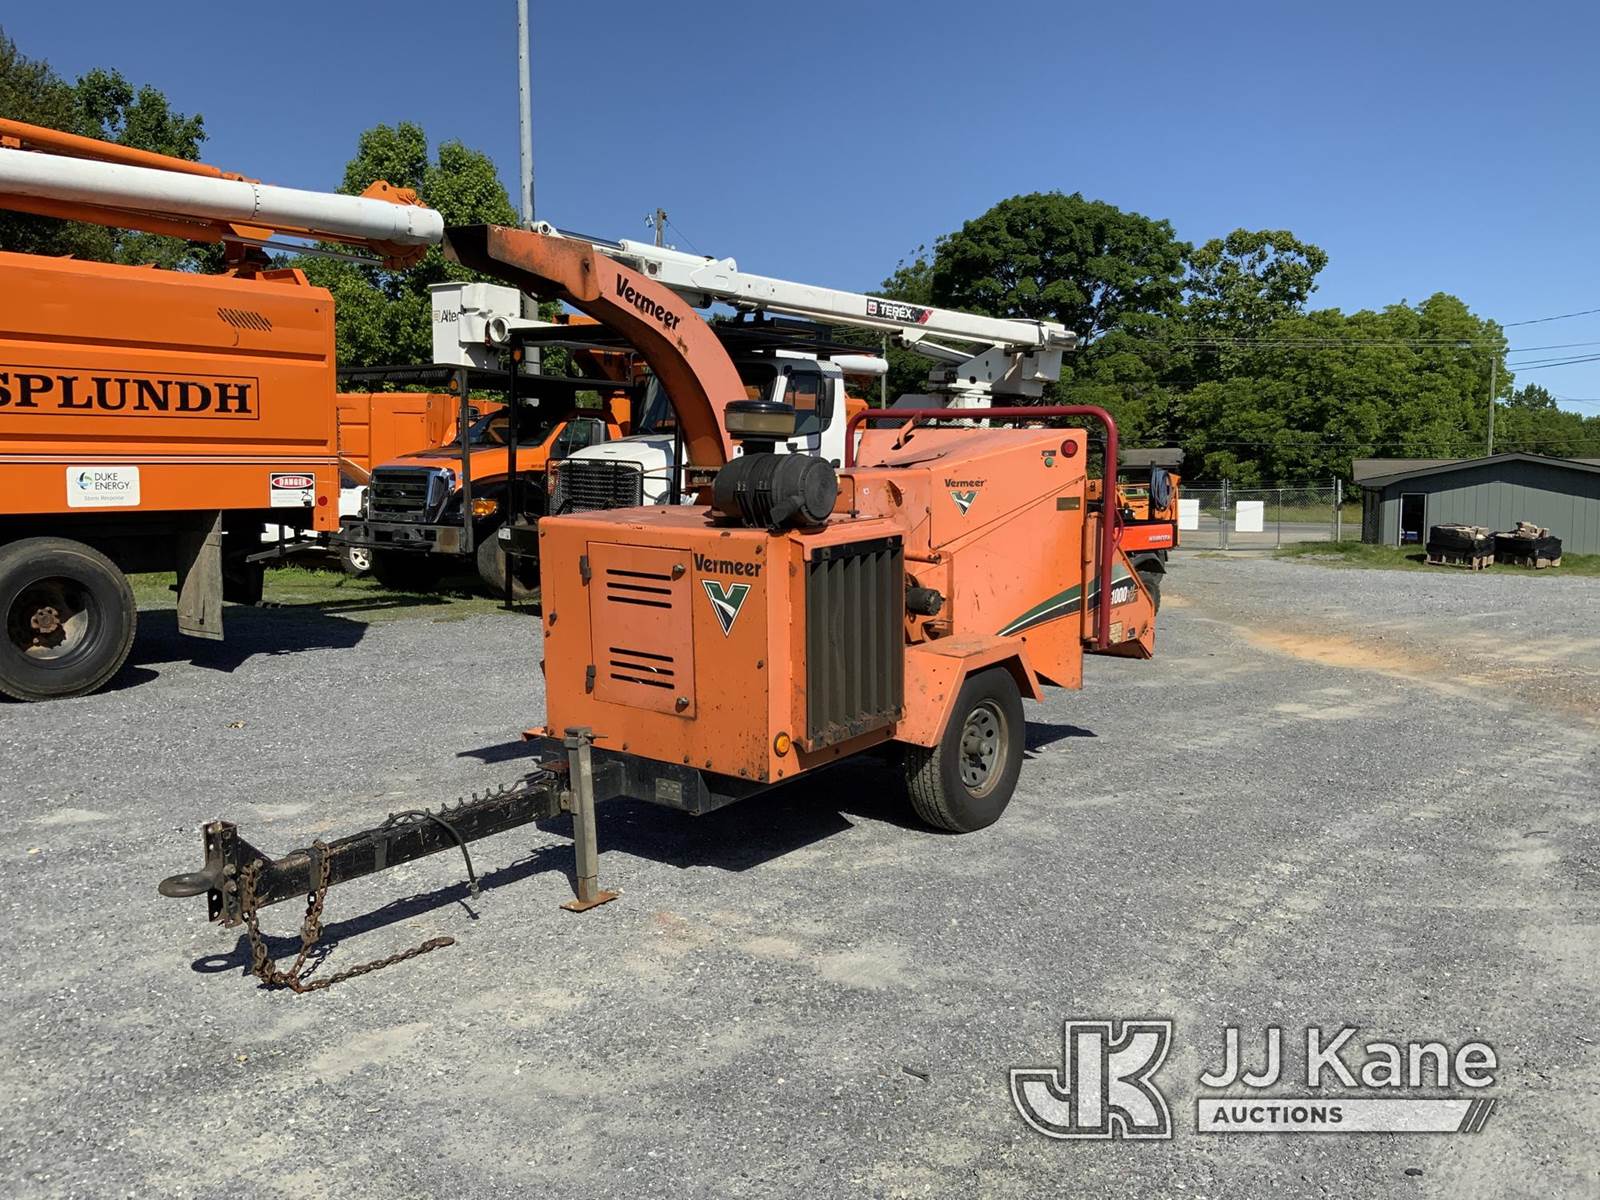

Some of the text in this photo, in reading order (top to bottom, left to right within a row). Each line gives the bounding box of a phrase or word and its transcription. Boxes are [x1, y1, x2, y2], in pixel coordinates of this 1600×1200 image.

[616, 272, 681, 330] Vermeer
[879, 302, 912, 320] TEREX
[94, 472, 119, 481] DUKE
[94, 481, 130, 491] ENERGY
[279, 477, 307, 487] DANGER
[944, 478, 985, 488] Vermeer
[693, 552, 762, 578] Vermeer
